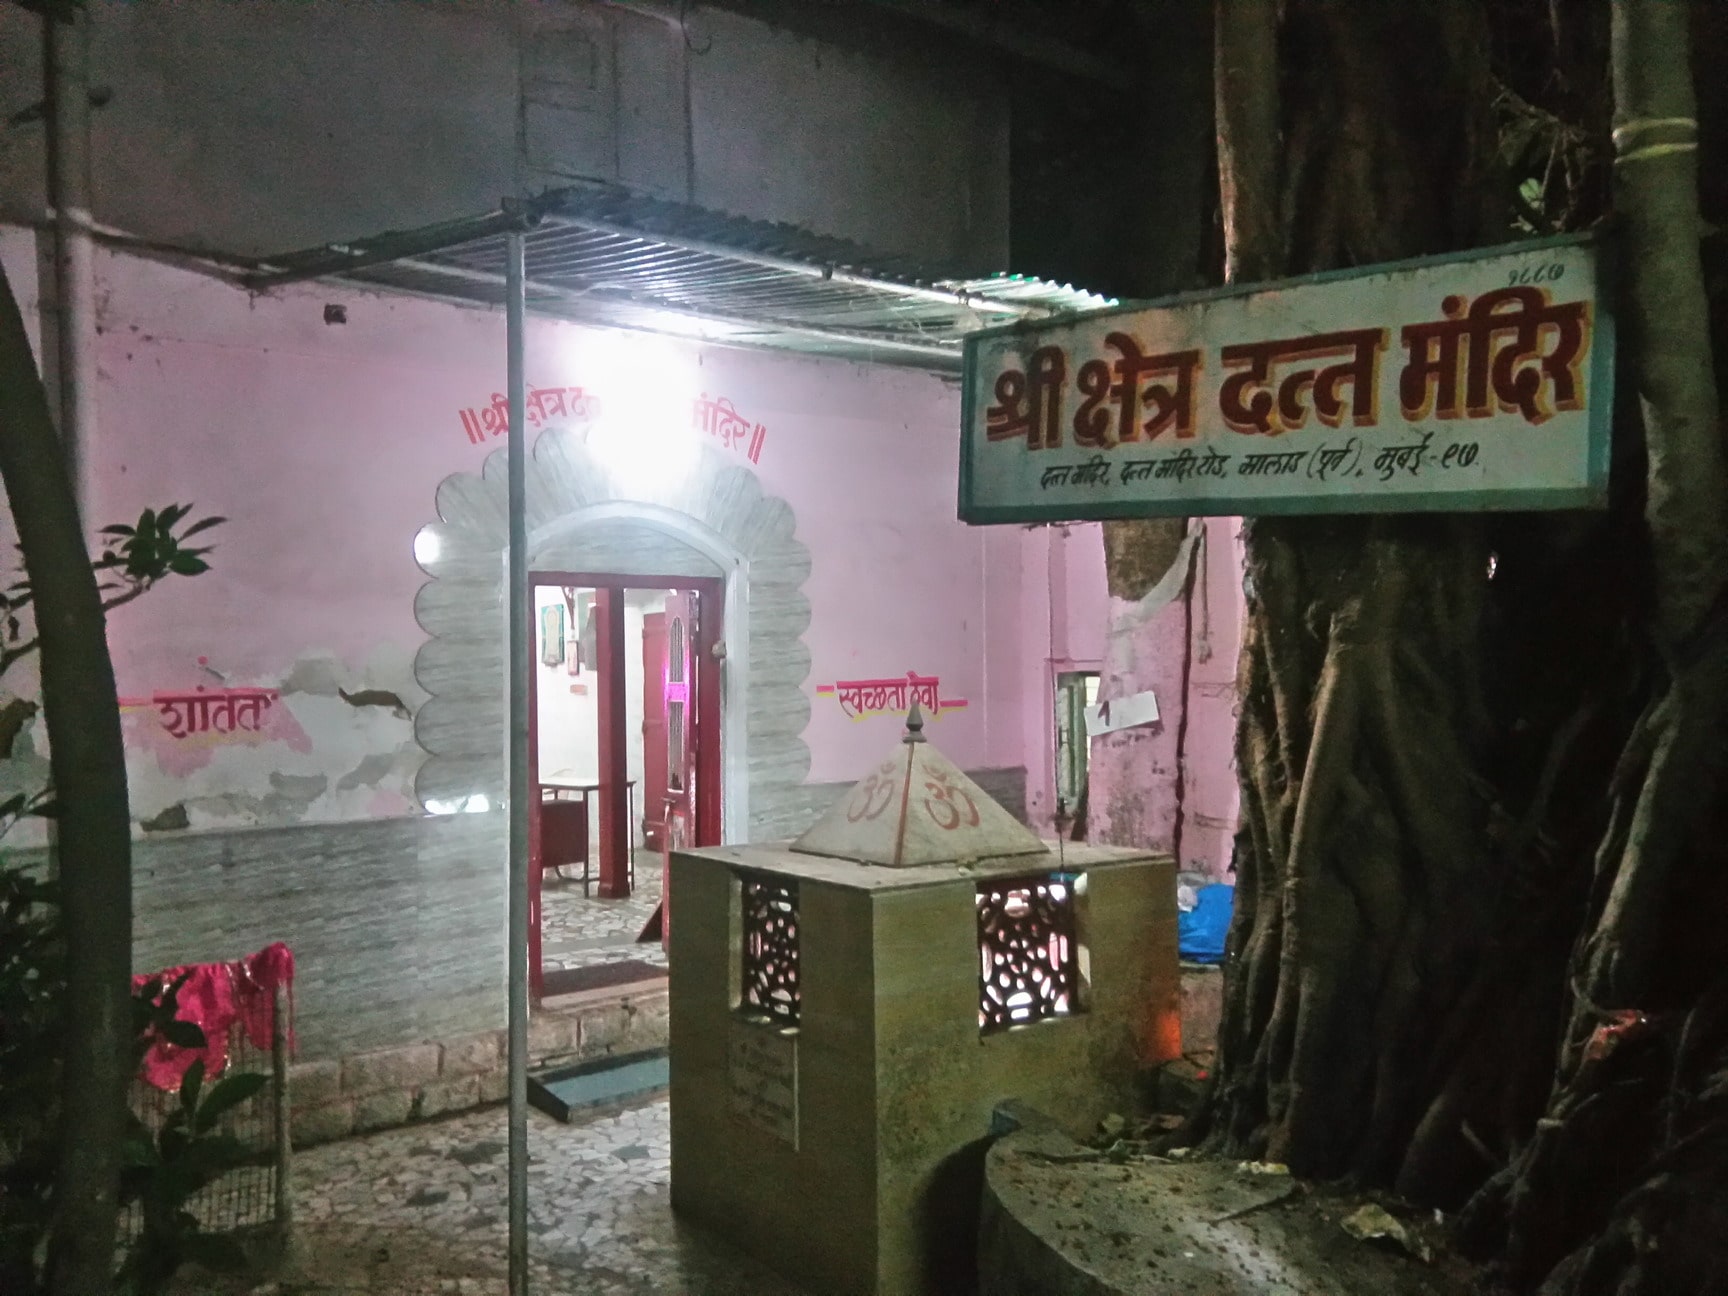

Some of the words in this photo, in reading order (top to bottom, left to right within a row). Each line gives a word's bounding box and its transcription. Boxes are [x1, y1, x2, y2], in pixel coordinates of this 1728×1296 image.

[986, 345, 1067, 450] श्री
[1073, 331, 1204, 450] क्षेत्र
[1219, 327, 1392, 437] दत्त
[1400, 286, 1592, 426] मंदिर
[1237, 450, 1308, 476] मालाड
